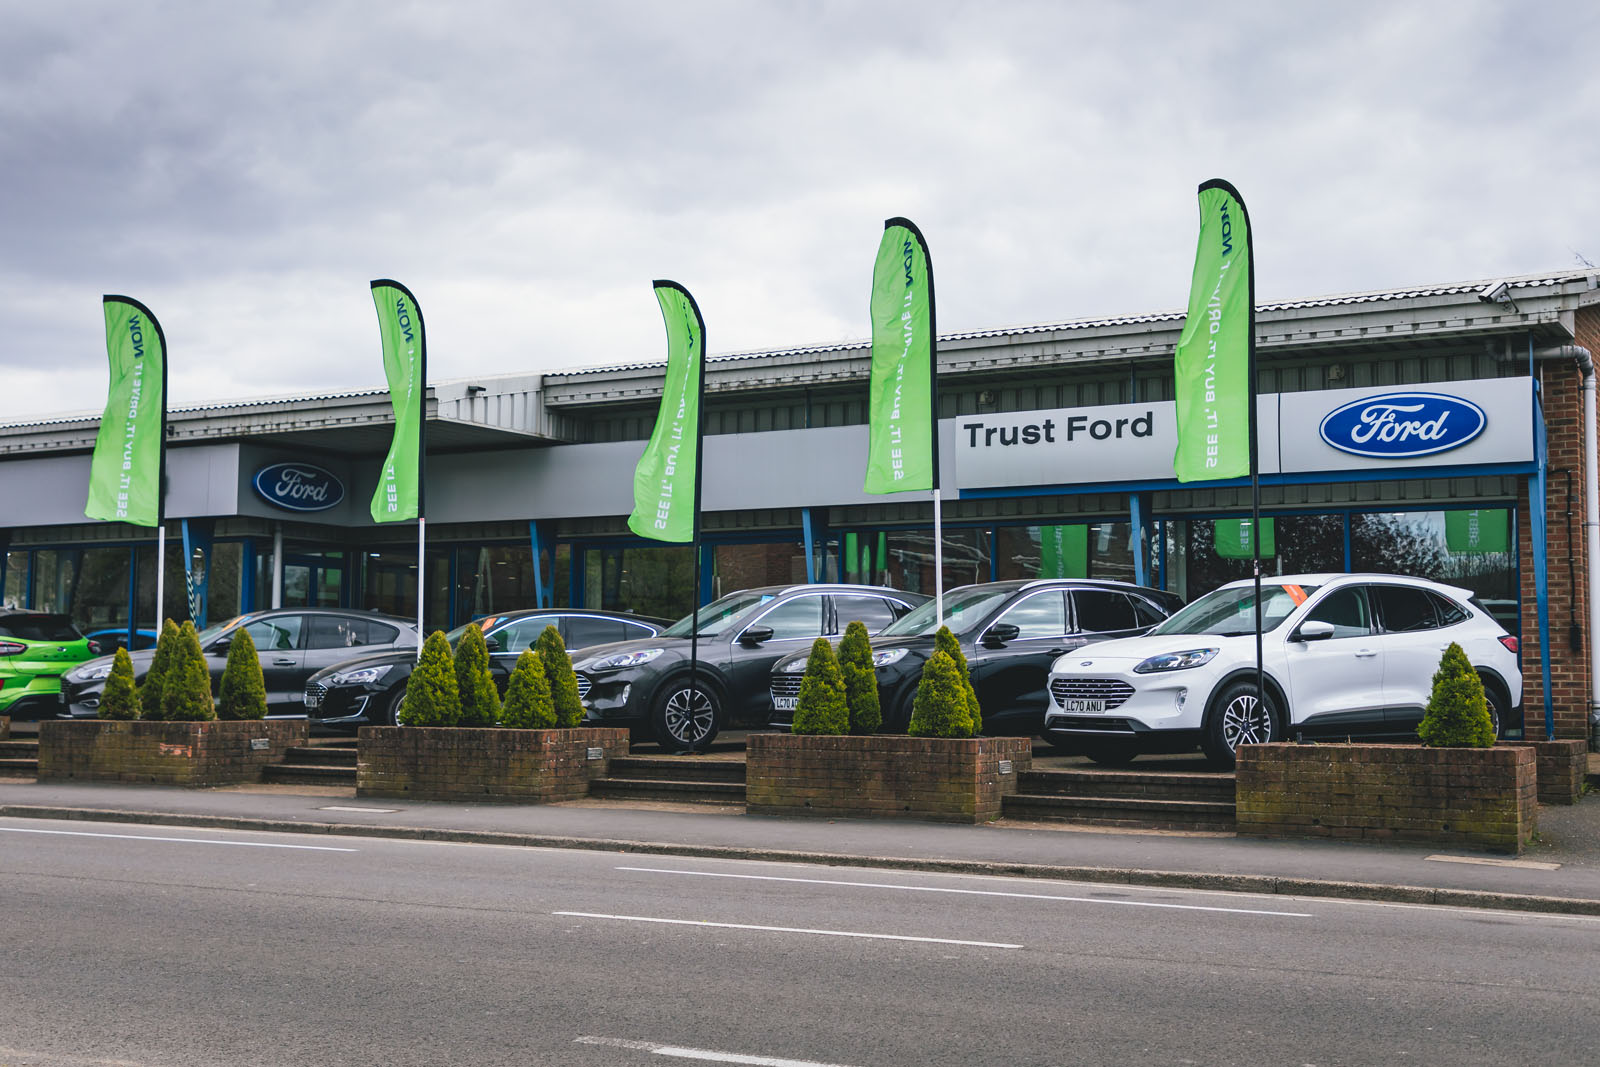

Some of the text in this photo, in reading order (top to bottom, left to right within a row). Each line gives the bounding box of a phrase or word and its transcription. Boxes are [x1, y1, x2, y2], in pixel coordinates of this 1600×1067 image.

[963, 411, 1153, 447] Trust Ford
[1351, 404, 1450, 444] Ford
[275, 468, 329, 502] Ford
[1066, 700, 1102, 711] LC70 ANU
